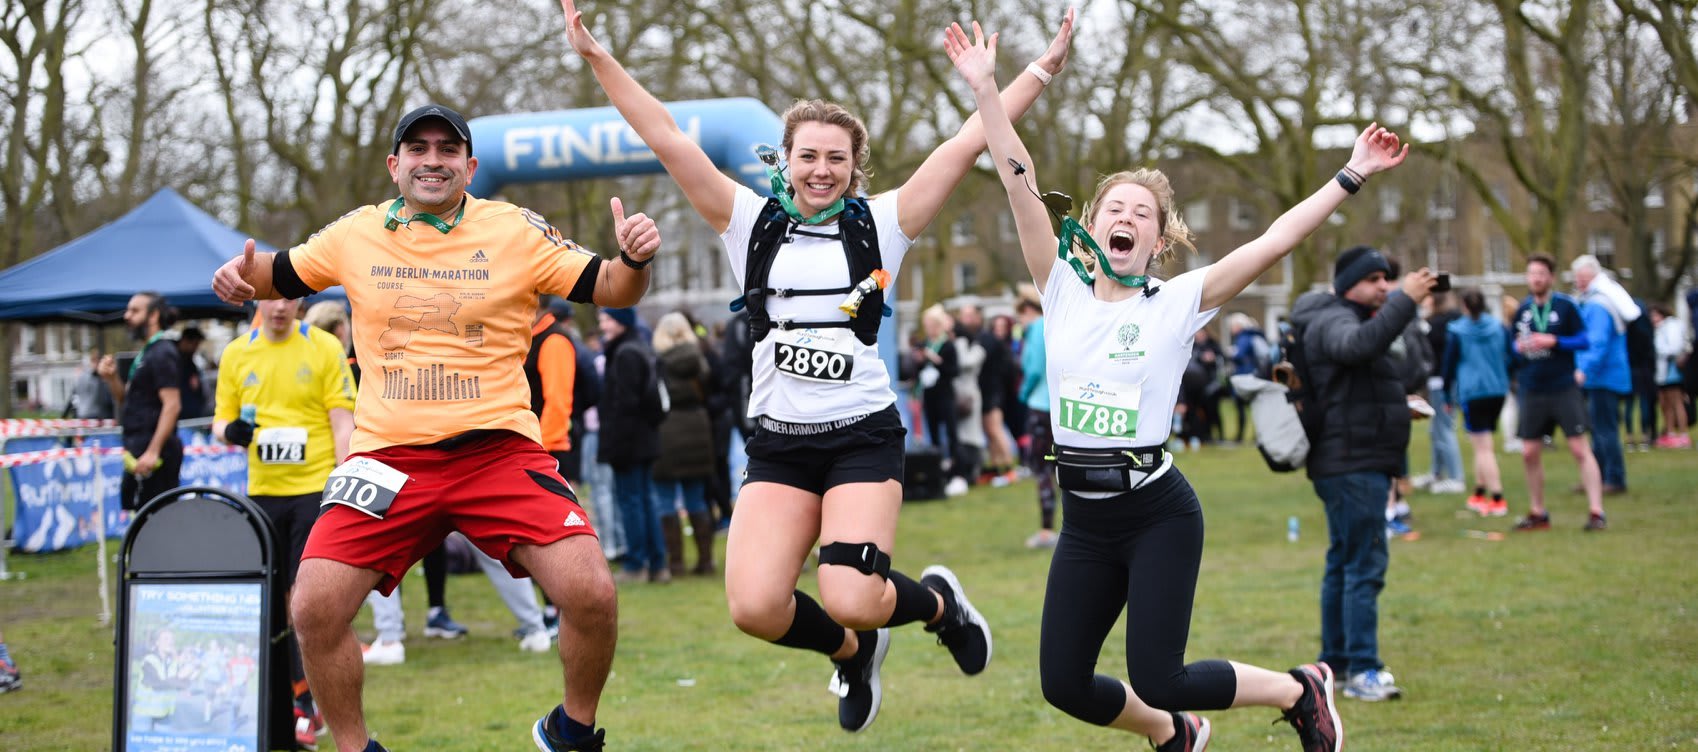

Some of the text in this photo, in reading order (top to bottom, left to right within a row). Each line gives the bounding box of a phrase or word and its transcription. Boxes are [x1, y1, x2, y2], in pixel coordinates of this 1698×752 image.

[371, 266, 490, 280] BMW BERLIN-MARATHON
[377, 281, 404, 290] COURSE
[384, 352, 404, 360] SIGHTS
[778, 344, 847, 379] 2890
[1065, 400, 1128, 436] 1788
[260, 443, 303, 461] 1178
[328, 476, 378, 507] 910
[141, 590, 163, 601] TRY
